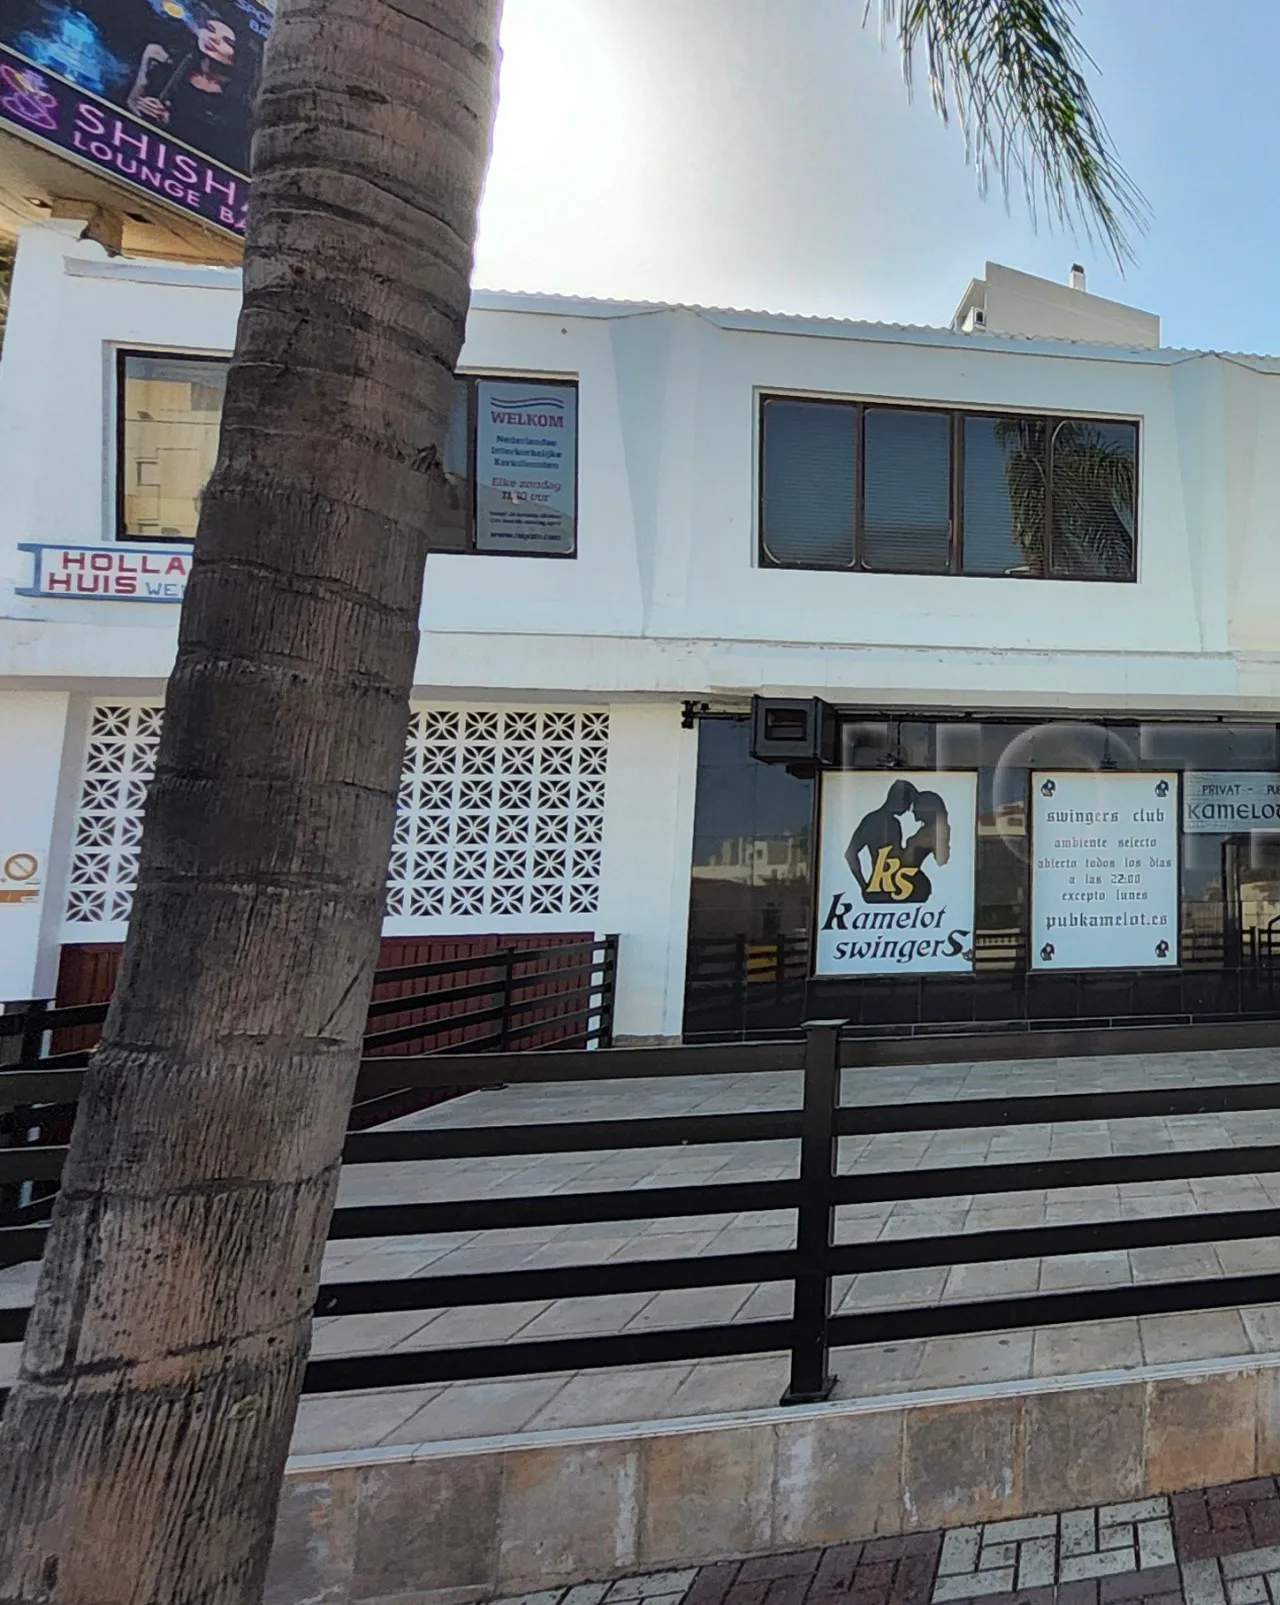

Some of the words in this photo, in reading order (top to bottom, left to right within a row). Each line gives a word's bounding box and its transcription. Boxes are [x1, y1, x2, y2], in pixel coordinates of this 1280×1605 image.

[74, 103, 249, 212] SHISH
[73, 130, 201, 208] LOUNGE
[490, 411, 565, 428] WELKOM
[62, 551, 186, 576] HOLLA
[49, 572, 138, 594] HUIS
[1202, 784, 1241, 796] PRIVAT
[1046, 809, 1119, 826] swingers
[1133, 808, 1165, 823] club
[1054, 837, 1108, 848] ambiente
[1117, 837, 1157, 848] selecto
[1037, 858, 1077, 869] abierto
[1085, 857, 1116, 868] todos
[1124, 858, 1142, 868] los
[1085, 874, 1102, 885] las
[1062, 890, 1106, 903] excepto
[1115, 889, 1148, 901] lunes
[1046, 911, 1168, 930] pubkamelot.es
